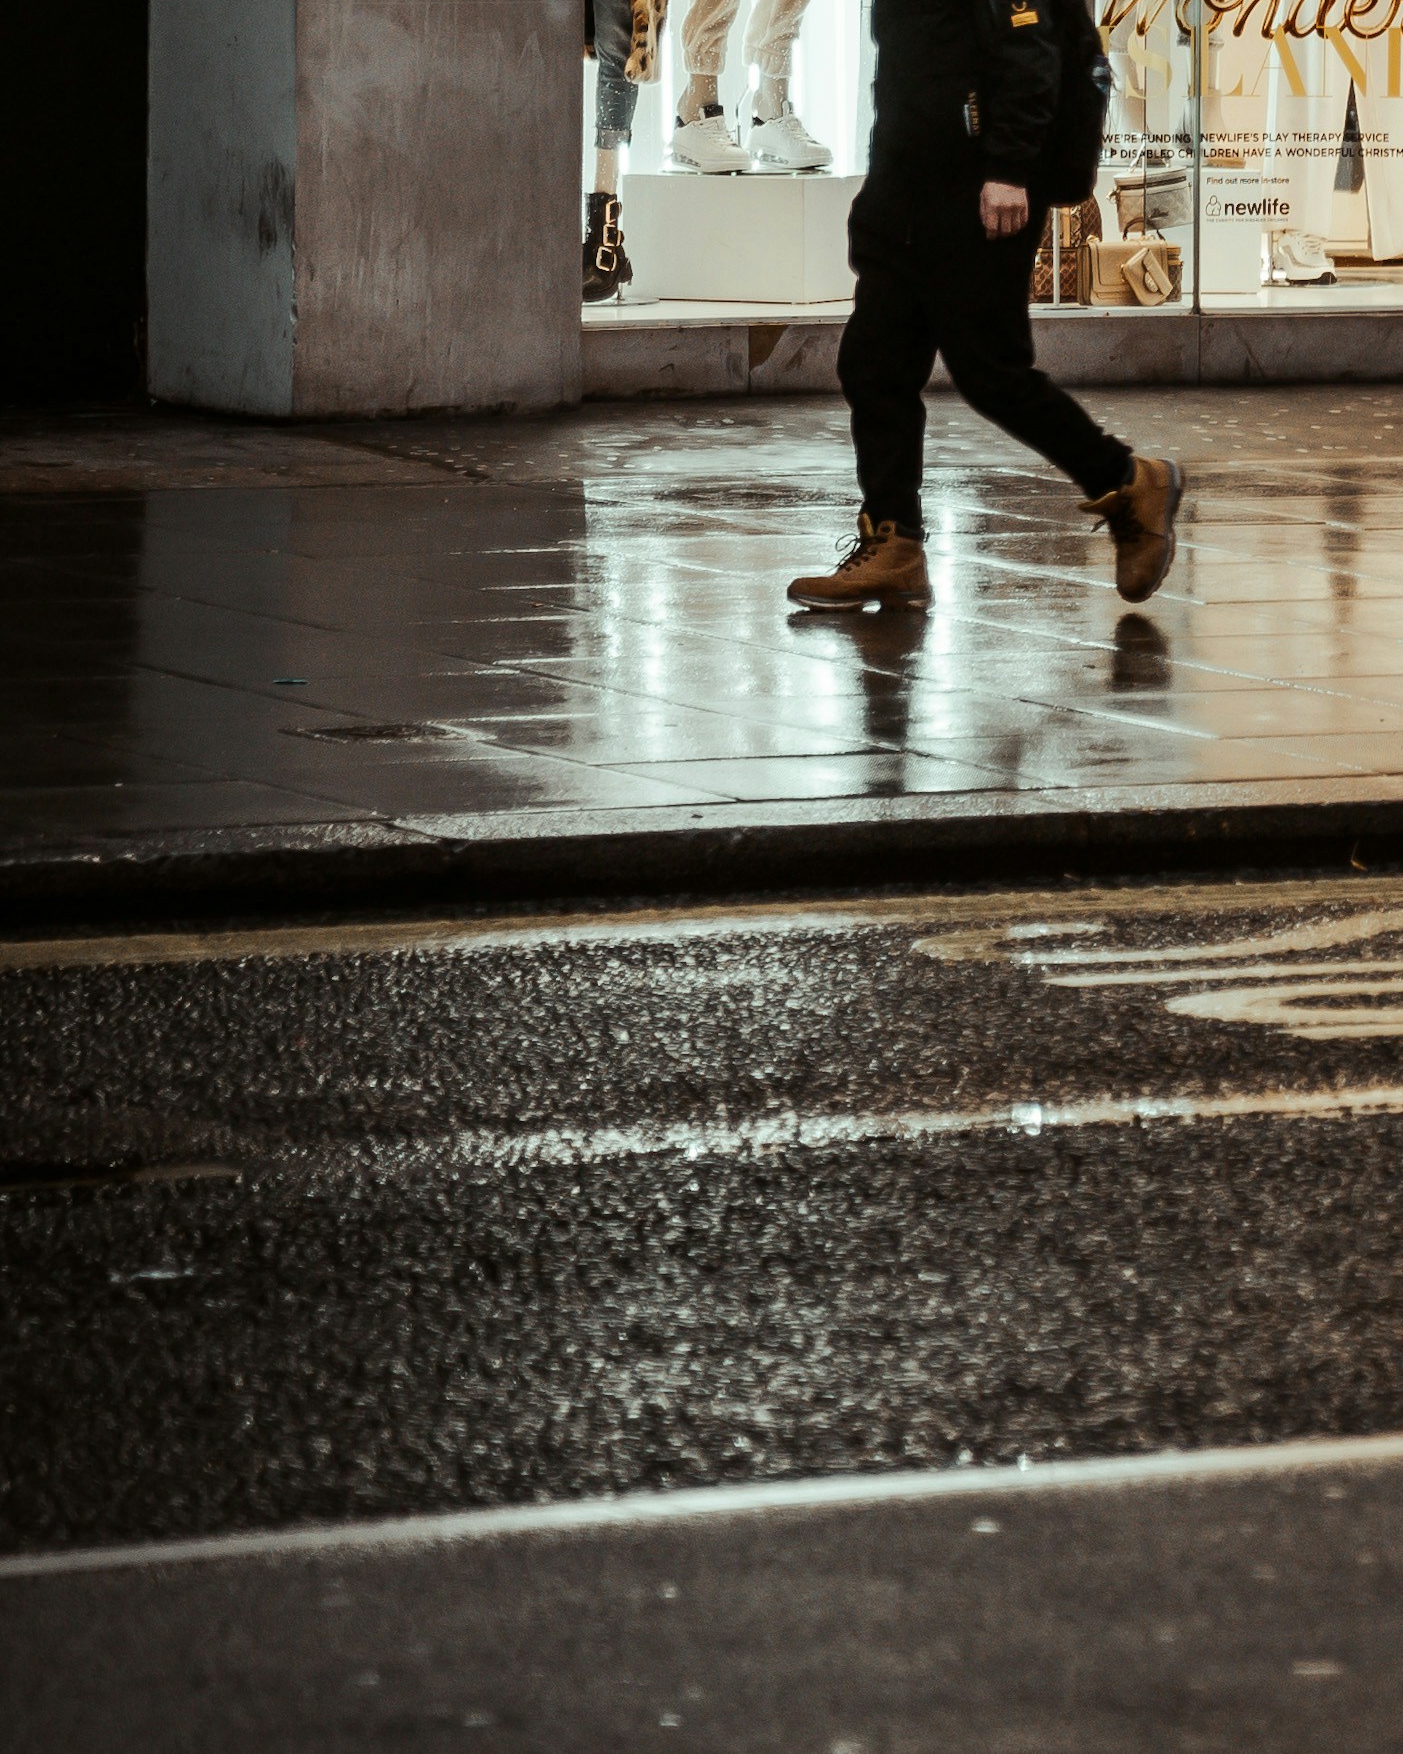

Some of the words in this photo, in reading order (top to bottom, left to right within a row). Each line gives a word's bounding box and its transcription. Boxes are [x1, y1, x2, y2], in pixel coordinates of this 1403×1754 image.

[1102, 133, 1138, 144] WE'RE
[1140, 133, 1192, 144] FUNDING
[1200, 132, 1260, 143] NEWLIFE'S
[1262, 132, 1289, 143] PLAY
[1291, 132, 1342, 143] THERAPY
[1343, 132, 1390, 143] SERVICE
[1120, 148, 1174, 159] DISABLED
[1177, 148, 1240, 158] CHILDREN
[1242, 148, 1272, 158] HAVE
[1274, 148, 1283, 158] A
[1285, 148, 1354, 158] WONDERFUL
[1206, 176, 1223, 185] Find
[1225, 177, 1238, 185] out
[1261, 176, 1290, 185] in-store
[1224, 197, 1290, 216] newlife
